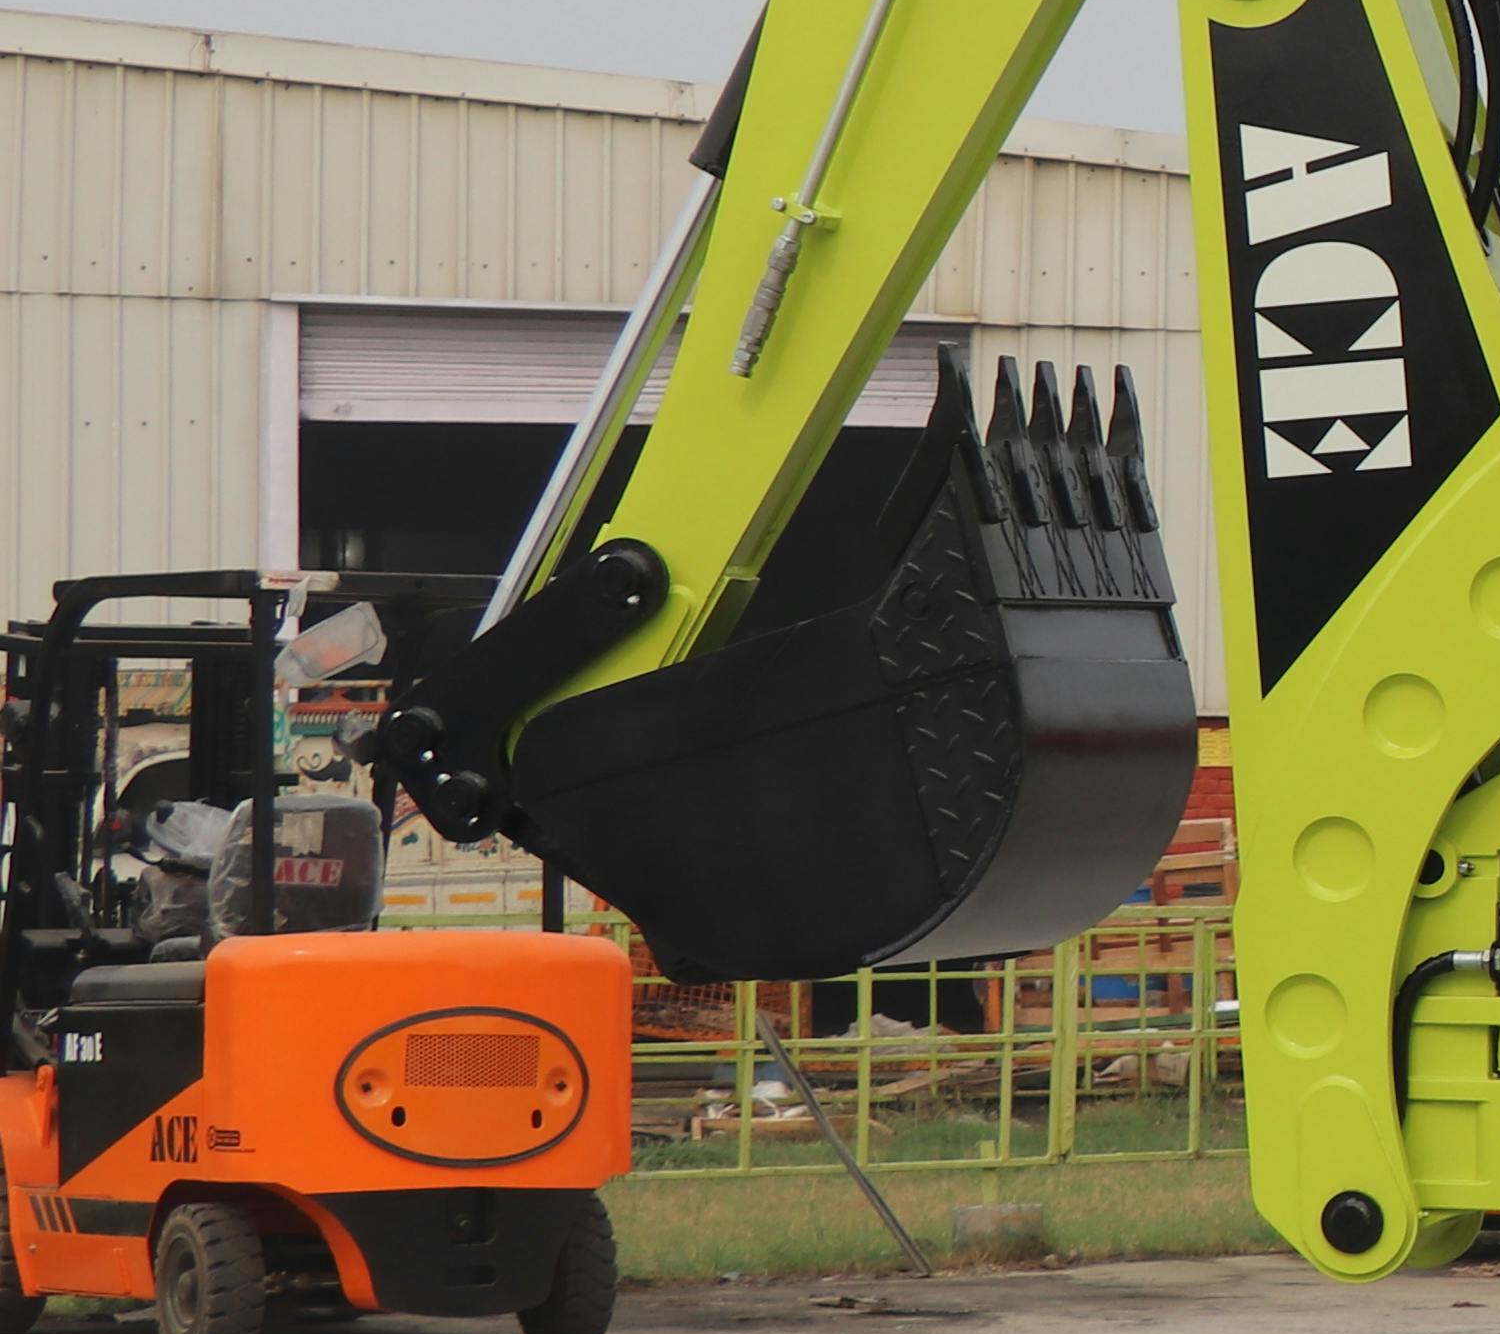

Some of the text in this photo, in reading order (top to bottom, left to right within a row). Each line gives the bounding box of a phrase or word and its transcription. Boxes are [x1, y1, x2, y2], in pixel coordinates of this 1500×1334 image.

[1239, 123, 1412, 479] ACE
[274, 858, 342, 885] ACE
[150, 1116, 198, 1164] ACE
